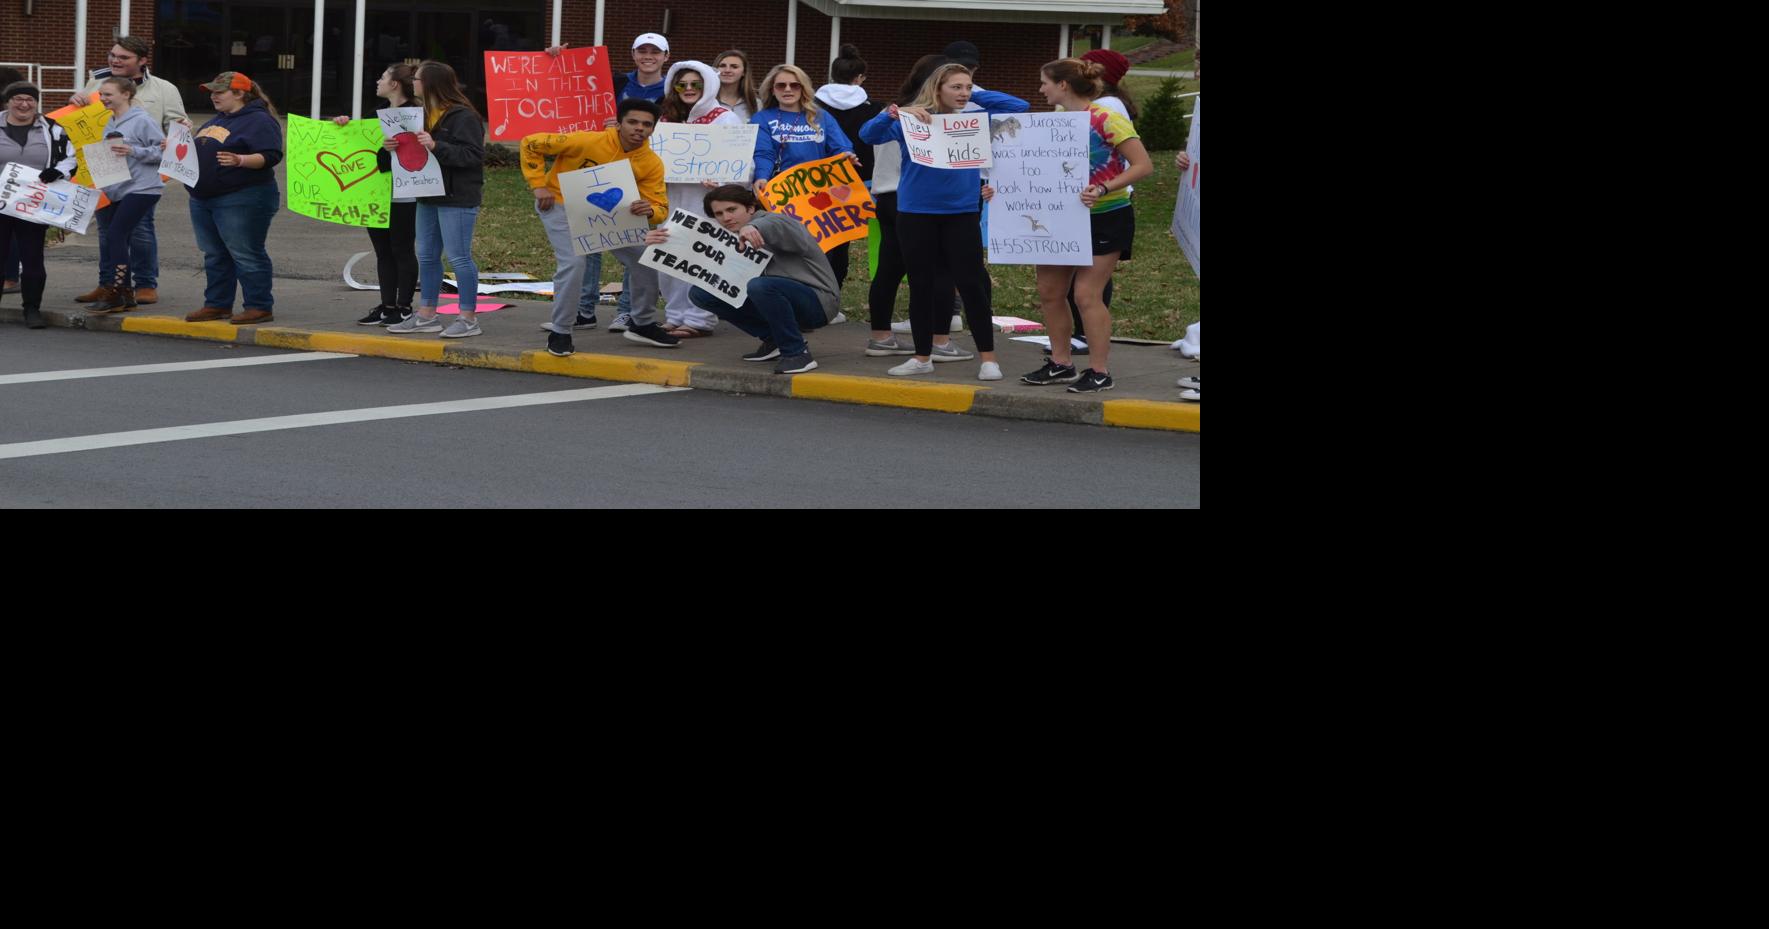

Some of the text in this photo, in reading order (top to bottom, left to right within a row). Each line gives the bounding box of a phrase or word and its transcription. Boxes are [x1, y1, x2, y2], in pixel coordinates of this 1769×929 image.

[548, 55, 585, 74] ALL
[505, 75, 597, 92] IN THIS
[494, 92, 614, 119] TOGETHER
[943, 118, 980, 131] Love
[1025, 115, 1077, 129] Jurassic
[650, 133, 712, 156] #55
[1050, 129, 1078, 142] Park
[992, 145, 1089, 160] was understaffed
[332, 158, 366, 175] LOVE
[583, 166, 612, 189] I
[771, 159, 855, 206] SUPPORT
[293, 180, 323, 200] OUR
[996, 180, 1022, 195] look
[1029, 180, 1052, 195] how
[16, 181, 49, 216] Publi
[1047, 201, 1065, 212] out
[310, 202, 389, 226] TEACHERS
[588, 211, 619, 228] MY
[804, 201, 877, 243] CHERS
[671, 210, 769, 264] WE SUPPORT
[991, 238, 1081, 254] #55STRONG
[692, 241, 726, 266] OUR
[652, 248, 741, 298] TEACHERS
